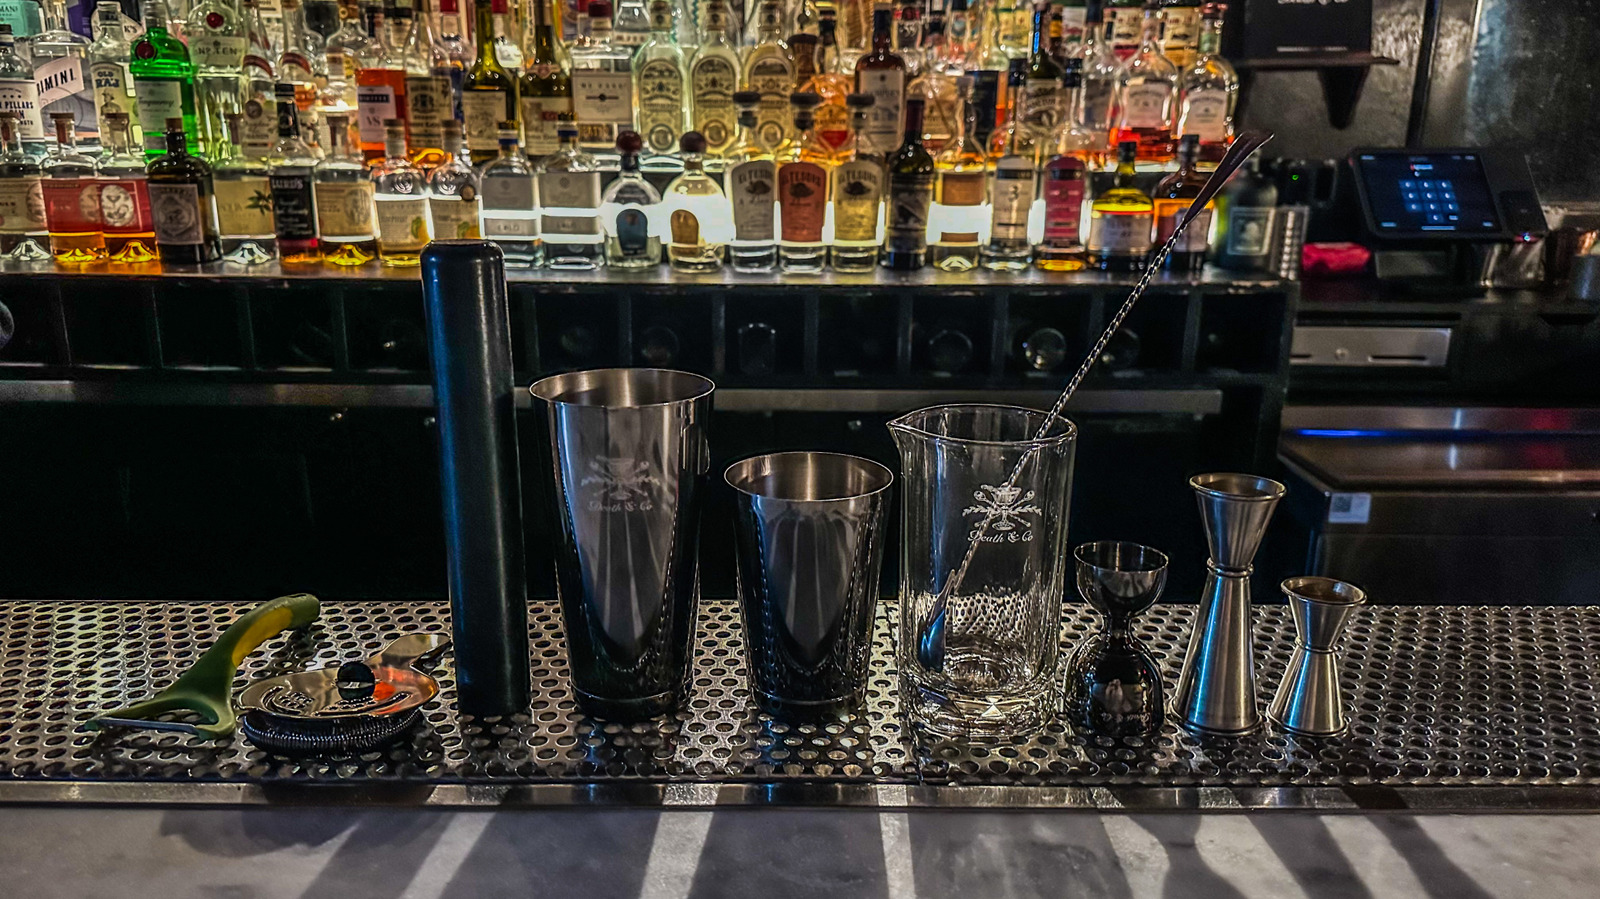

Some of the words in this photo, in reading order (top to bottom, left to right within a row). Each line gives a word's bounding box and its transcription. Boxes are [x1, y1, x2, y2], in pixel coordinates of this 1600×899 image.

[96, 78, 120, 89] RAJ
[5, 101, 34, 109] PILLARS
[967, 530, 1004, 543] Death
[1007, 531, 1020, 543] &
[1022, 530, 1034, 542] Co
